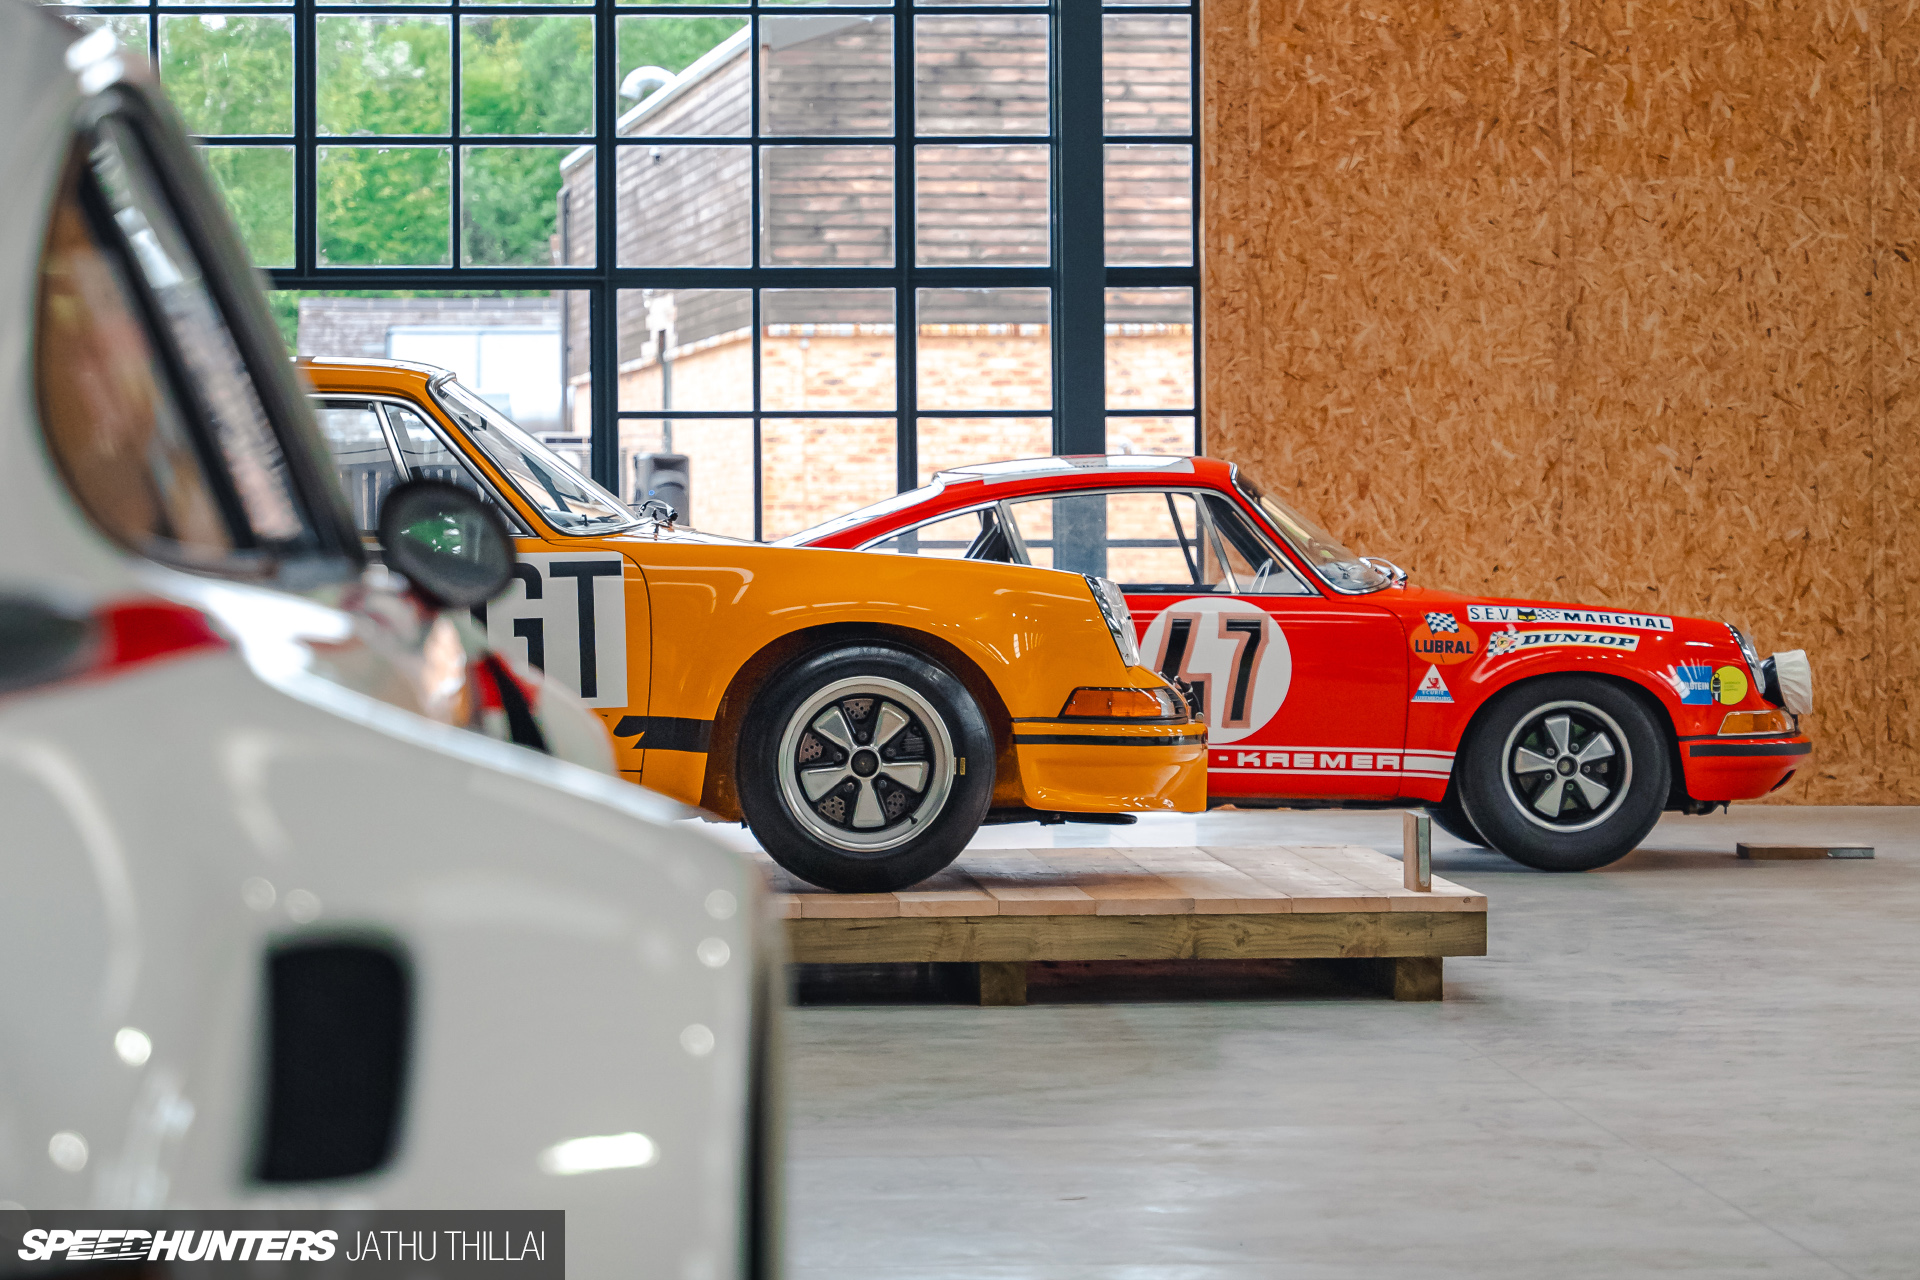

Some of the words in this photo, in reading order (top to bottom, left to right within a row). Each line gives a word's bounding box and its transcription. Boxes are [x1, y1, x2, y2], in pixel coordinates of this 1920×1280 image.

[1564, 611, 1671, 630] MARCHAL
[470, 562, 621, 698] GT
[1415, 640, 1474, 654] LUBRAL
[1521, 633, 1636, 647] DUNLOP
[1155, 612, 1269, 728] 47
[1237, 752, 1400, 770] KREMER
